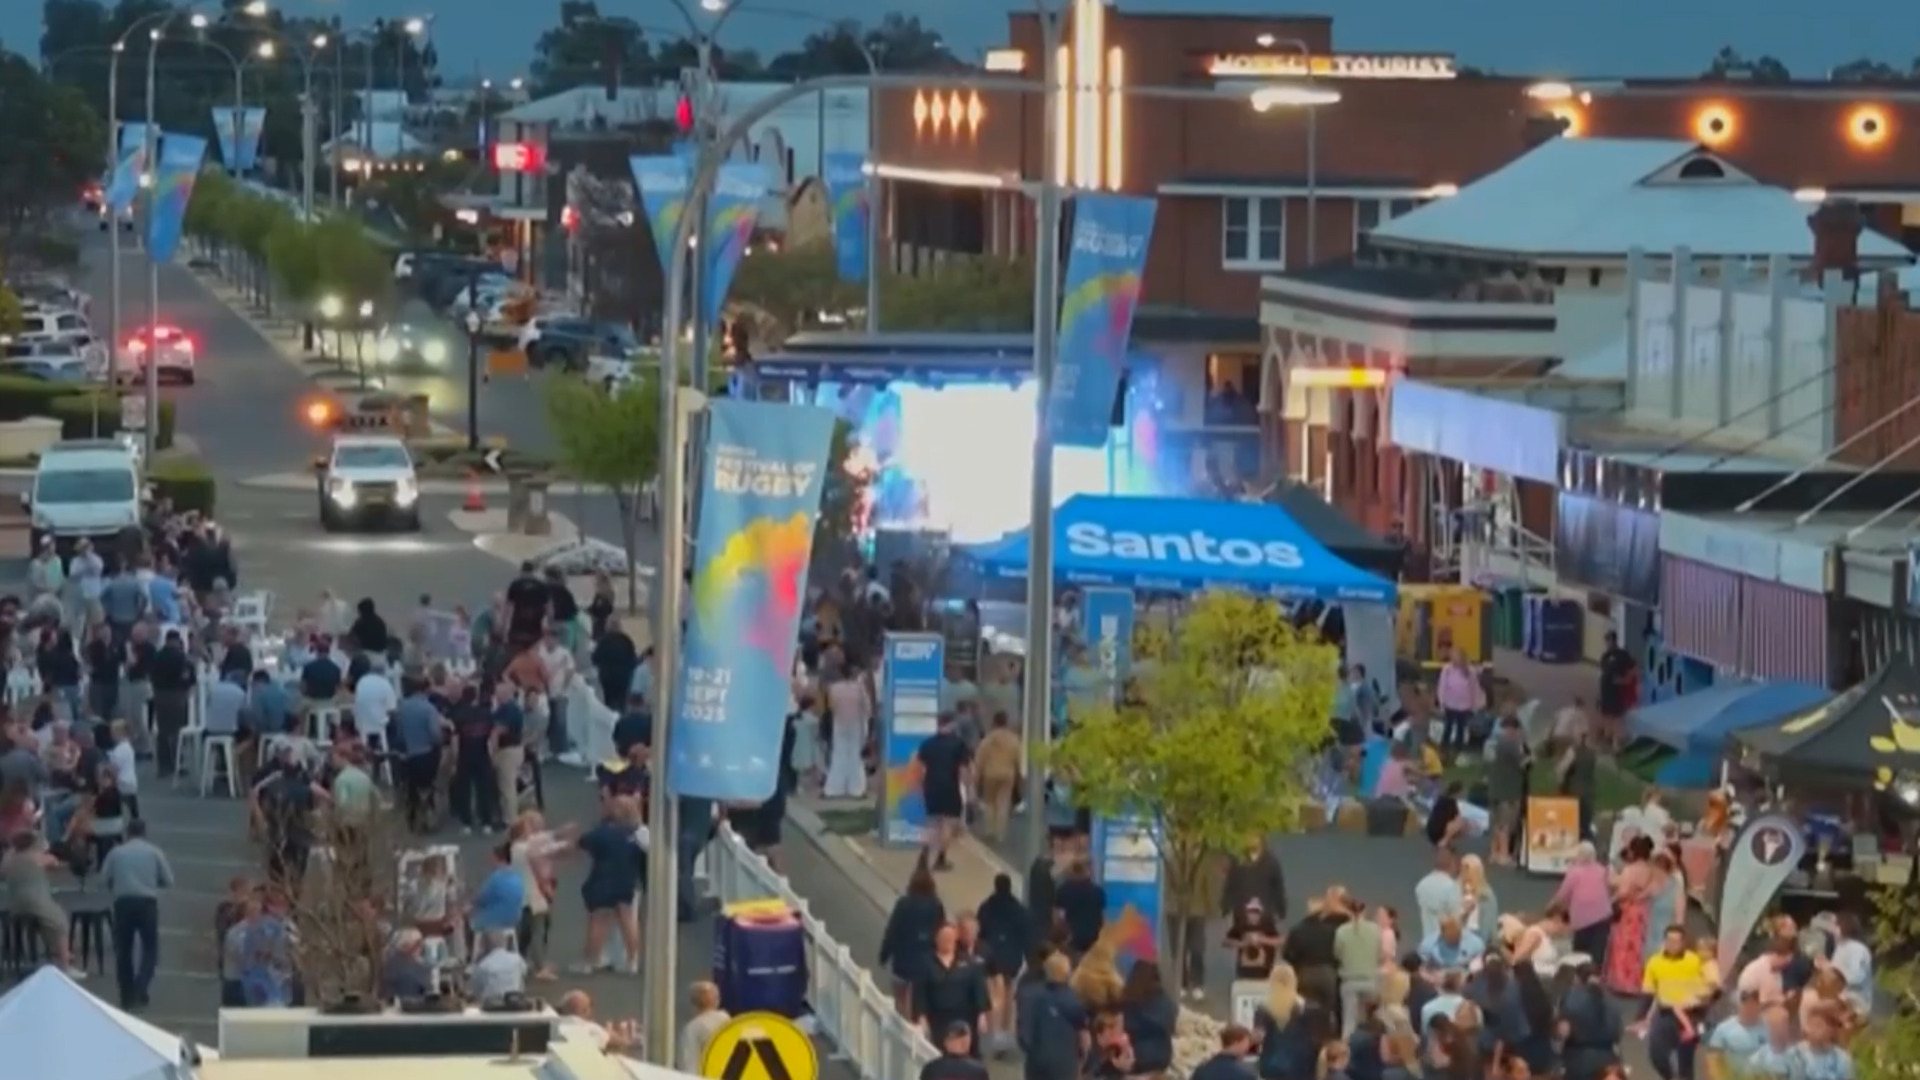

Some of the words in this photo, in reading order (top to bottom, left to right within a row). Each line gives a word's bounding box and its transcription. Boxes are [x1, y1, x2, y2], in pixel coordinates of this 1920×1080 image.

[1334, 55, 1456, 78] TOURIST
[714, 468, 813, 497] RUGBY
[1065, 521, 1304, 569] Santos
[685, 684, 728, 703] SEPT
[681, 701, 726, 722] 2025
